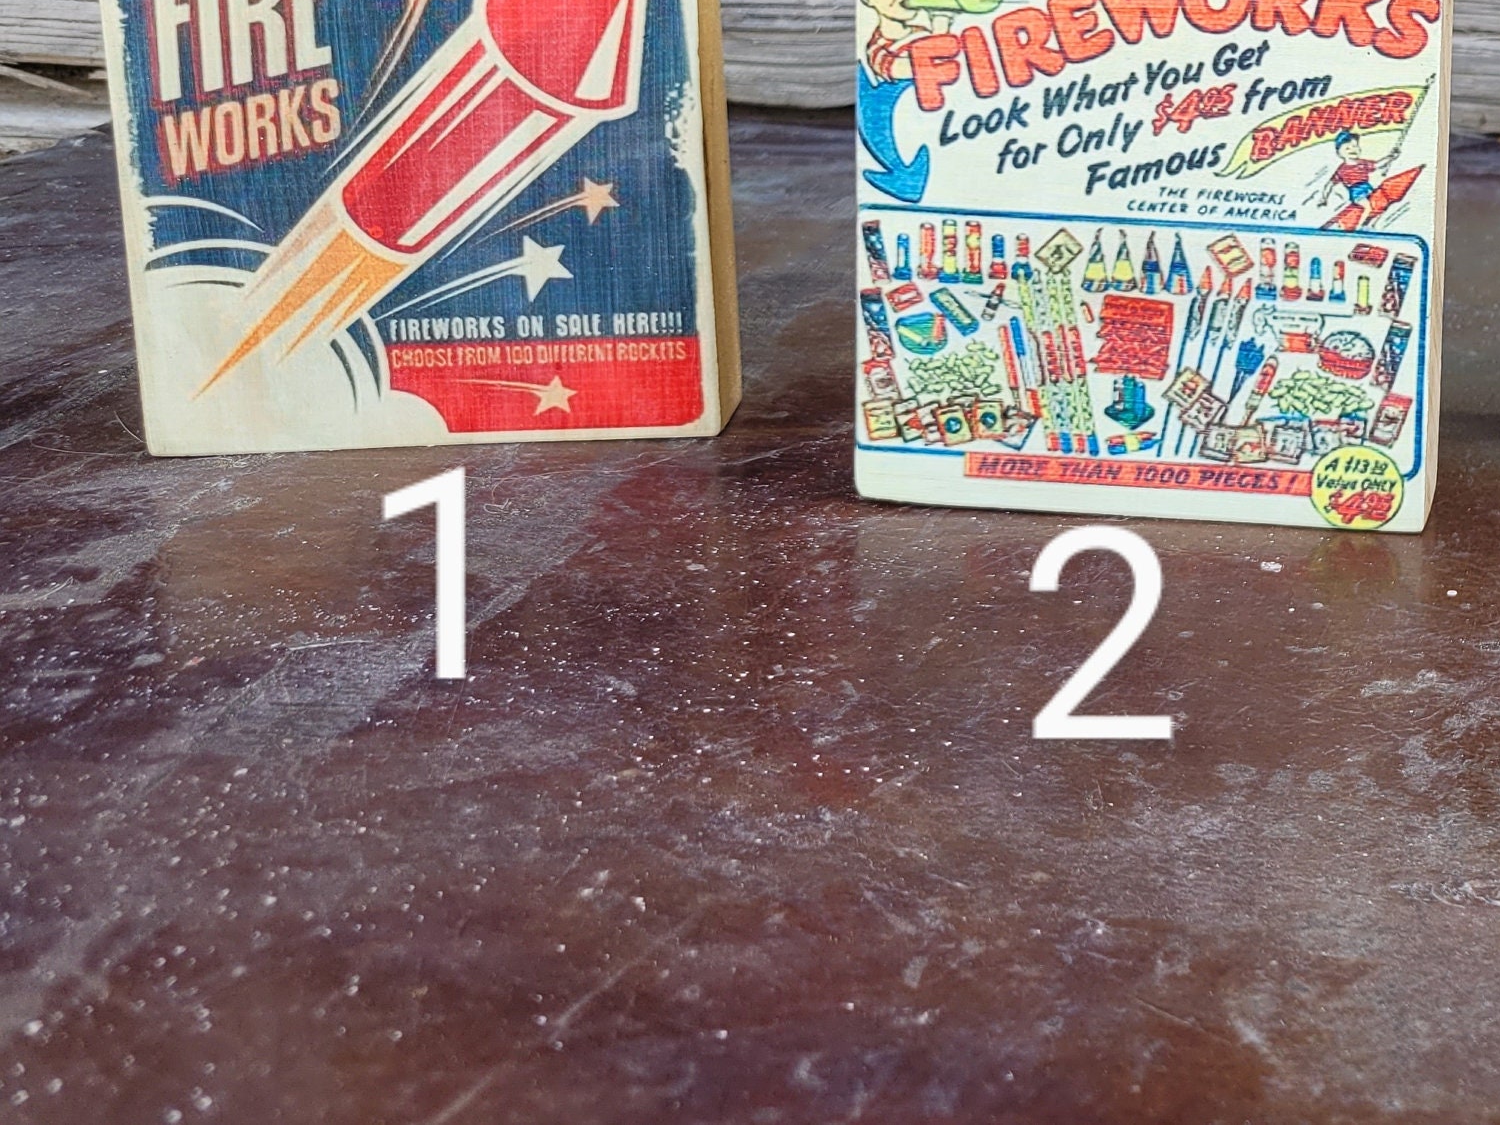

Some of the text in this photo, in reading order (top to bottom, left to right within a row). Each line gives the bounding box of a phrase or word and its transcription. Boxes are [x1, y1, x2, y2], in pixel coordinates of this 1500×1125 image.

[939, 40, 1270, 147] Look What You Get
[162, 78, 342, 177] WORKS
[996, 138, 1049, 175] for
[1057, 112, 1144, 159] Only
[1241, 74, 1333, 115] from
[1085, 90, 1414, 196] Famous BANNER
[1158, 185, 1286, 206] THE FIREWORKS
[1126, 200, 1298, 222] CENTER OF AMERICA
[390, 311, 684, 341] FIREWORKS ON SALE HERE!!!
[391, 340, 687, 369] CHOOSE FROM 100 DIFFERENT ROCKETS
[977, 455, 1049, 477] MORE
[1060, 460, 1122, 481] THAN
[1134, 465, 1192, 486] 1000
[1324, 456, 1340, 473] A
